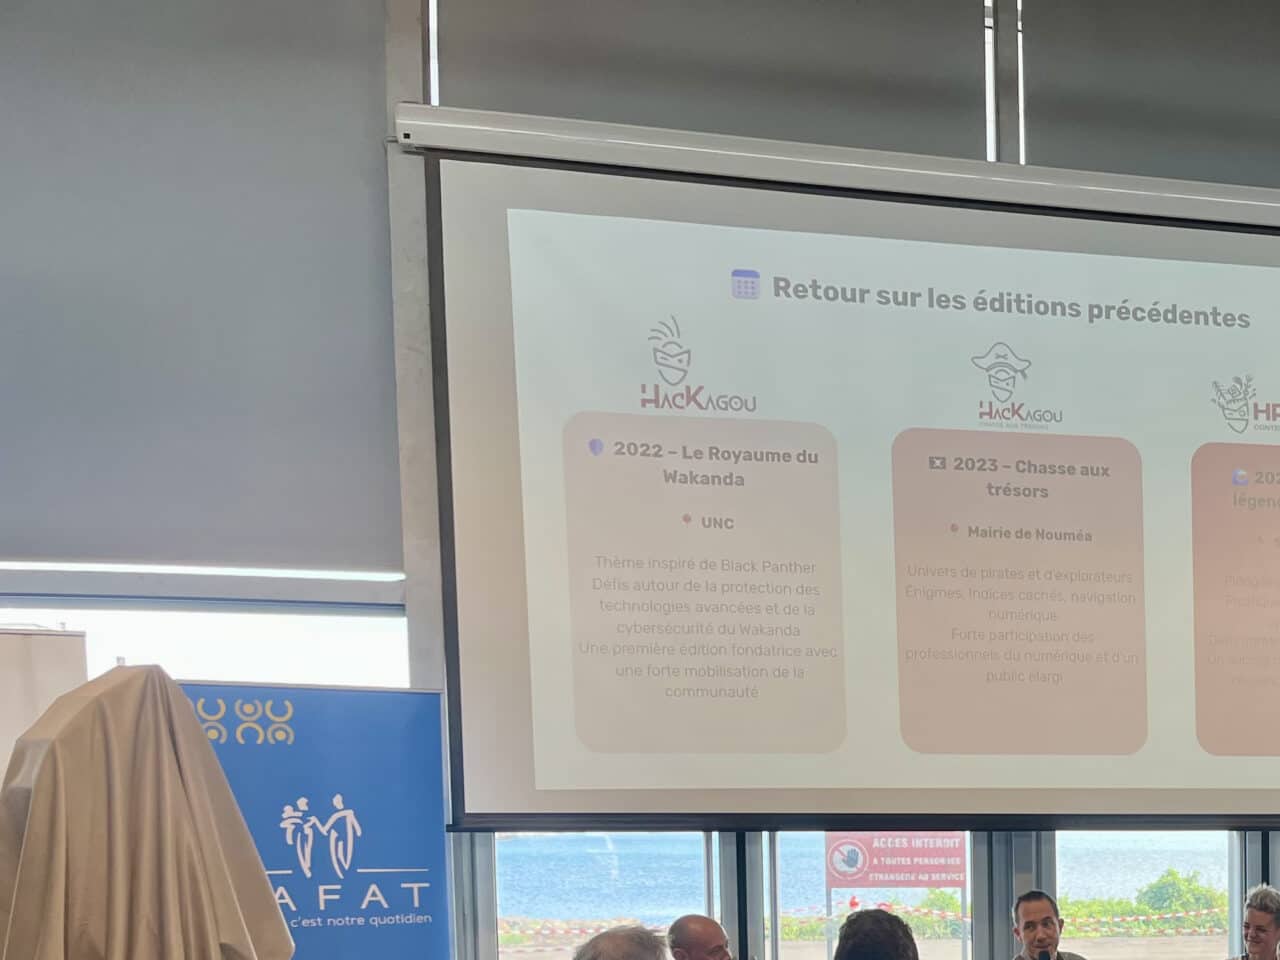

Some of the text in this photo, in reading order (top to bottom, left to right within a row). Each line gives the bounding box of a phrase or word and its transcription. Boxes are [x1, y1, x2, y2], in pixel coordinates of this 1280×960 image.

[773, 276, 1251, 330] Retour sur les éditions précédentes
[613, 441, 664, 458] 2022
[682, 446, 704, 460] Le
[708, 446, 793, 465] Royaume
[796, 449, 819, 464] du
[953, 456, 999, 473] 2023
[1015, 459, 1077, 477] Chasse
[1080, 464, 1111, 478] aux
[663, 469, 745, 486] Wakanda
[986, 481, 1049, 499] trésors
[701, 516, 735, 530] UNC
[967, 525, 1093, 543] Mairie de Nouméa
[594, 555, 817, 575] Thème inspiré de Black Panther
[961, 566, 977, 579] de
[1028, 568, 1041, 581] et
[592, 577, 821, 598] Défis autour de la protection des
[1071, 590, 1137, 607] navigation
[600, 600, 816, 616] technologies avancées et de la
[616, 621, 801, 637] cybersécurité du Wakanda
[951, 627, 985, 641] Forte
[988, 628, 1069, 644] participation
[578, 641, 838, 659] Une première édition fondatrice avec
[1003, 649, 1021, 662] du
[616, 664, 806, 680] une forte mobilisation de la
[664, 685, 760, 699] communauté
[911, 838, 961, 848] INTERDIT
[880, 857, 912, 865] TOUTES
[931, 872, 965, 881] SERVICE
[274, 882, 431, 911] AFAT
[290, 913, 433, 929] c'est notre quotidien
